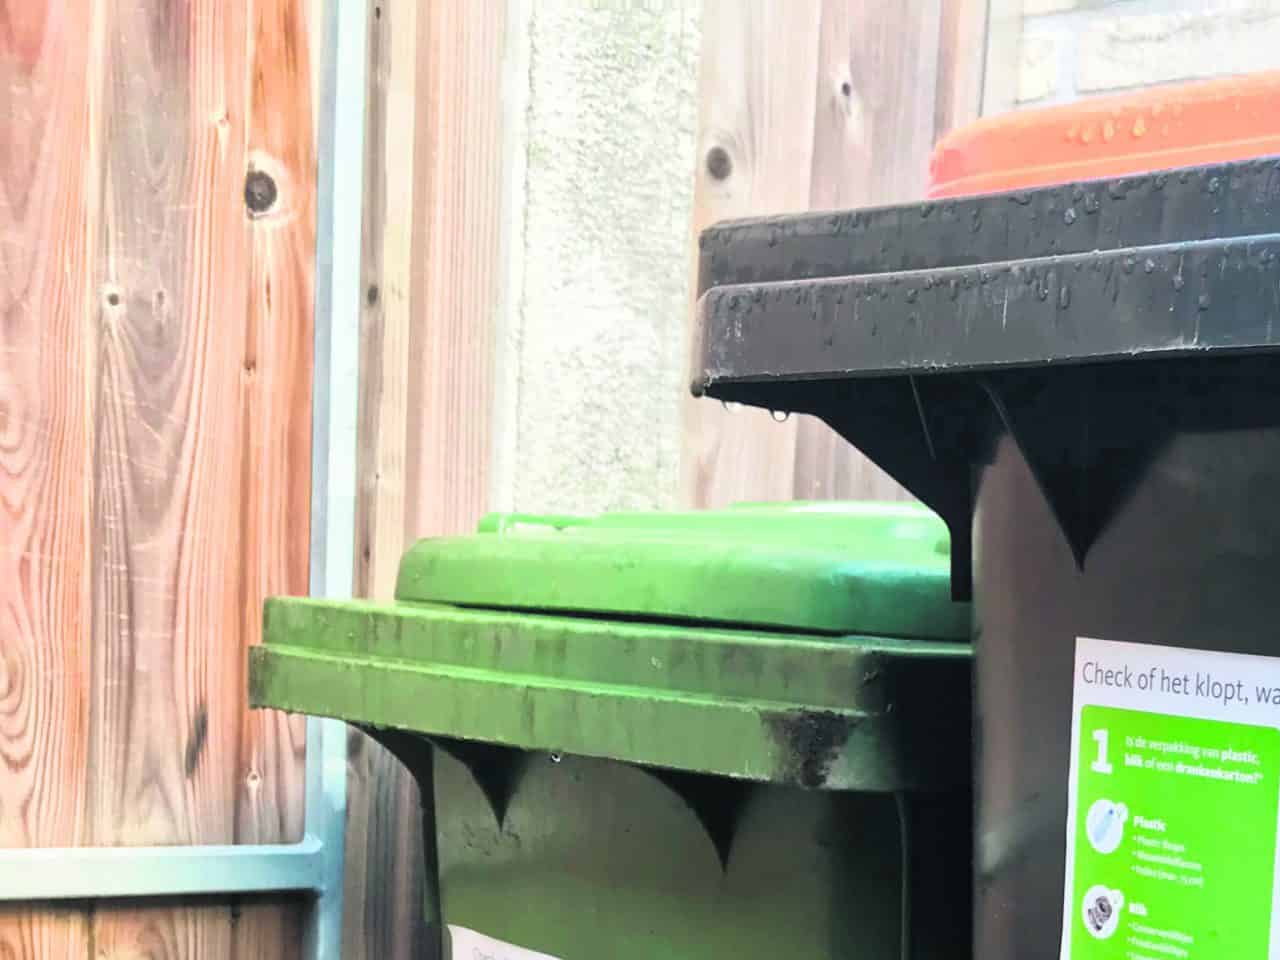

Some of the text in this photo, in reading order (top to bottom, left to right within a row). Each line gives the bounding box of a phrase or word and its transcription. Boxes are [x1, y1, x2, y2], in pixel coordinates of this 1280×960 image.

[1082, 661, 1133, 688] Check
[1137, 667, 1157, 691] of
[1160, 669, 1190, 694] het
[1195, 674, 1249, 706] klopt,
[1090, 728, 1114, 775] 1
